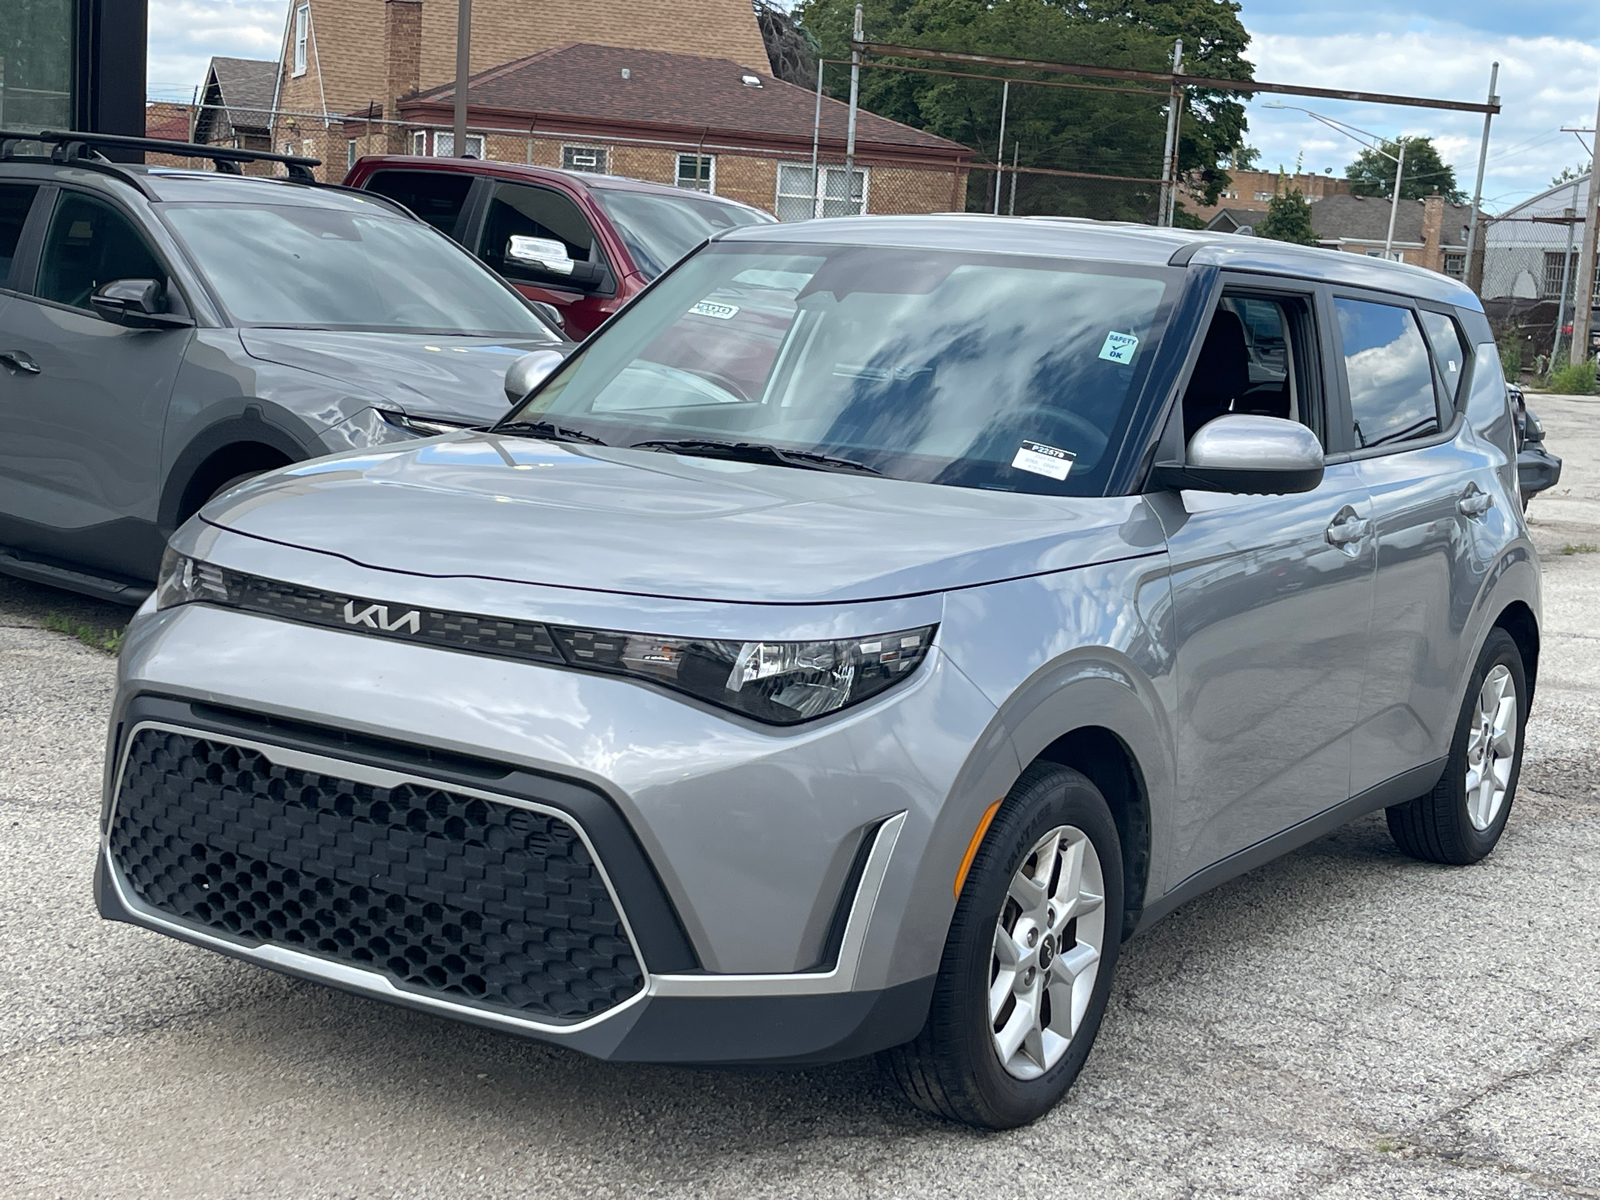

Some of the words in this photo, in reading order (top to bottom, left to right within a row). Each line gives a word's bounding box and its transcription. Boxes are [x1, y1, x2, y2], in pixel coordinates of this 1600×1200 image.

[1109, 335, 1136, 345] SAFETY
[1109, 351, 1122, 359] OK
[344, 600, 420, 634] KIA
